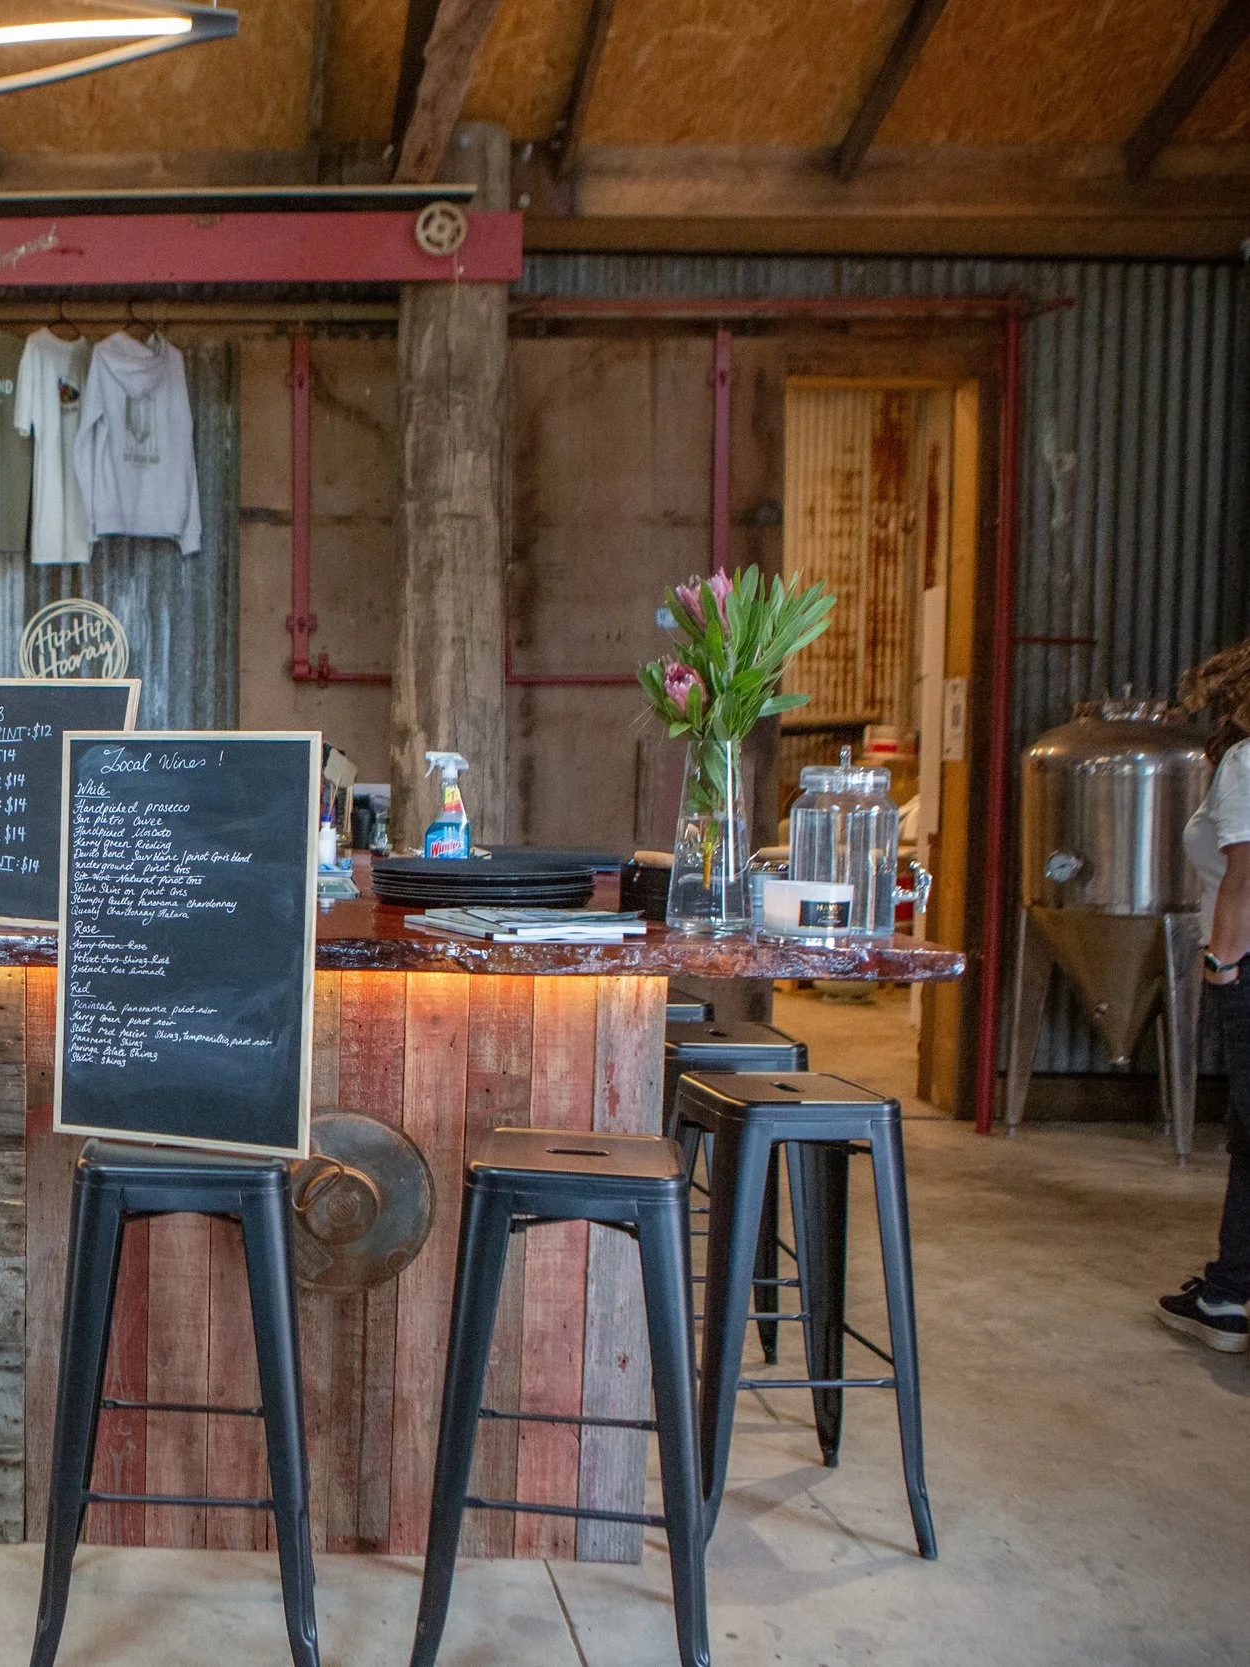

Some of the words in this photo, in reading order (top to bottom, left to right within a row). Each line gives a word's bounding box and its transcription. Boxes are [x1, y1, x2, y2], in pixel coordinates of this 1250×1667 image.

[158, 752, 206, 770] Wines
[4, 772, 26, 790] $14
[75, 778, 111, 798] White
[4, 796, 28, 816] $14
[144, 802, 191, 816] prosecco
[72, 814, 91, 825] San
[4, 824, 27, 845] $14
[142, 862, 171, 876] pinot
[70, 980, 93, 997] Red
